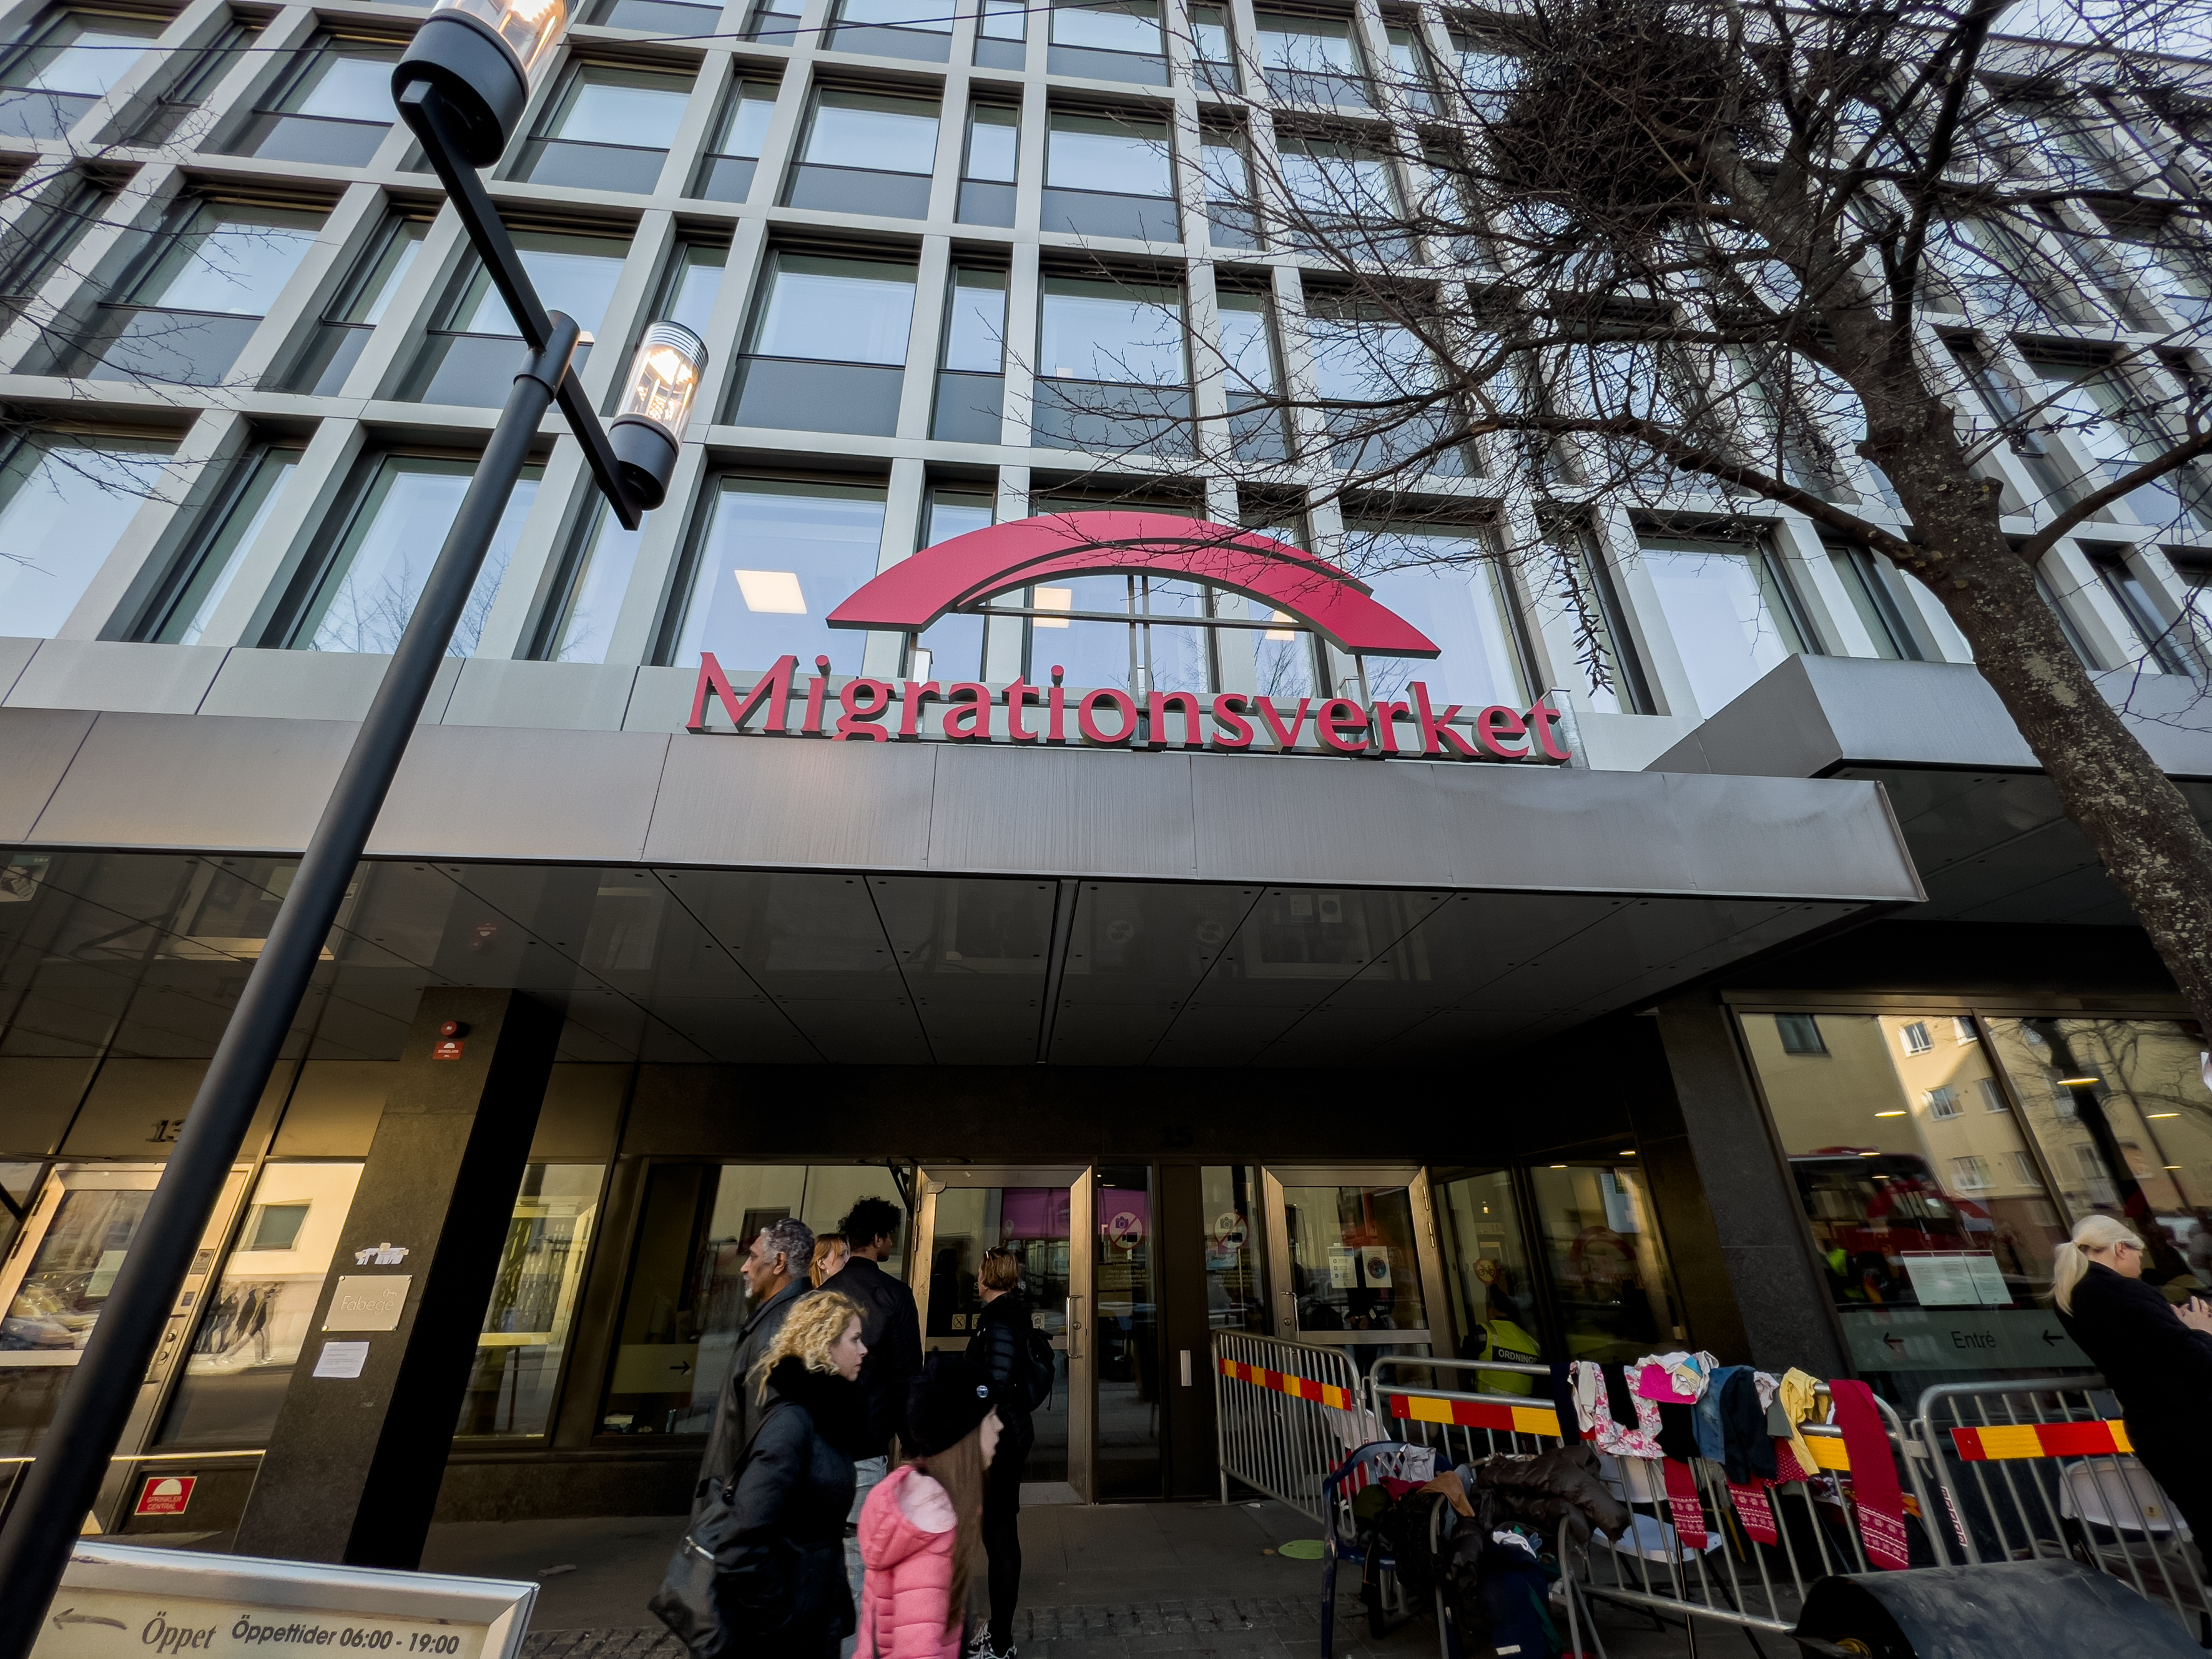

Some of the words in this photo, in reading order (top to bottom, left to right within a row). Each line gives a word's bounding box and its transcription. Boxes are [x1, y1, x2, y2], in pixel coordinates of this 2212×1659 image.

[686, 652, 1573, 764] Migrationsverket
[1161, 1126, 1193, 1147] 15
[340, 1295, 394, 1315] Fabege
[1950, 1331, 1997, 1349] Entré
[142, 1611, 217, 1655] Öppet
[232, 1615, 338, 1647] Öppettider
[340, 1627, 393, 1650] 06:00
[408, 1632, 460, 1655] 19:00
